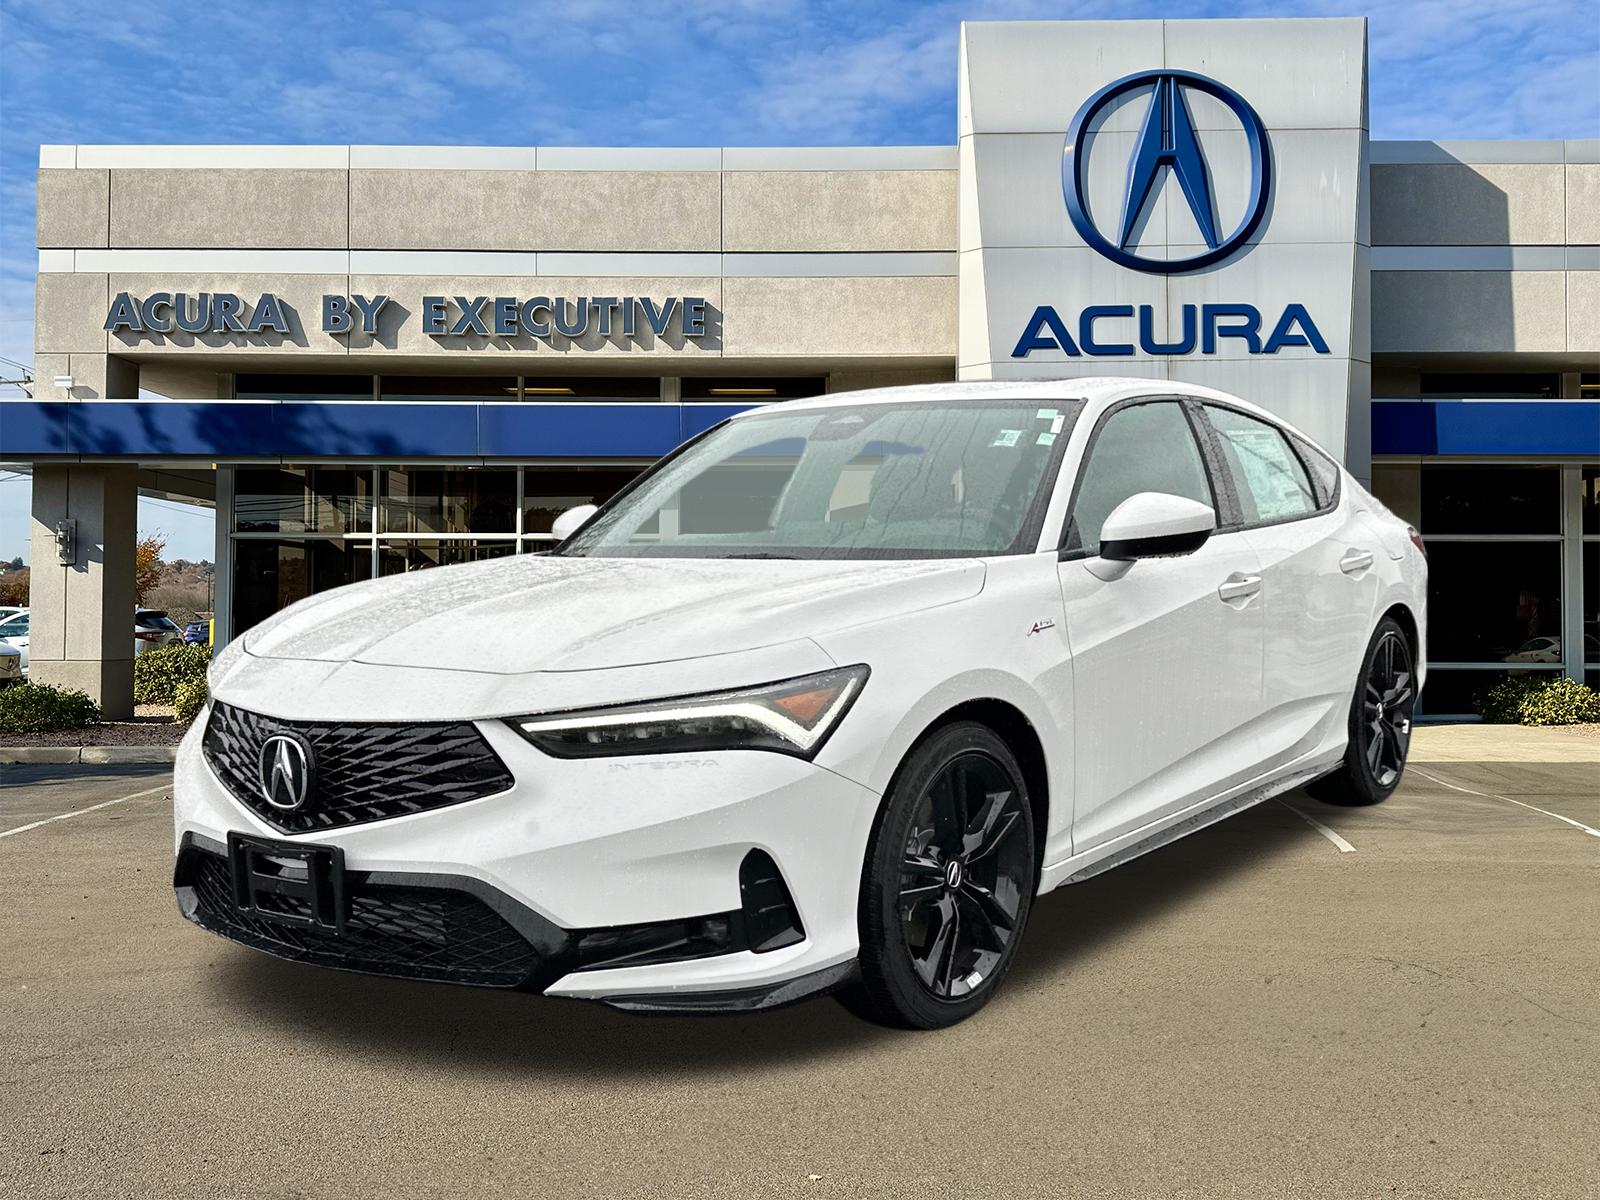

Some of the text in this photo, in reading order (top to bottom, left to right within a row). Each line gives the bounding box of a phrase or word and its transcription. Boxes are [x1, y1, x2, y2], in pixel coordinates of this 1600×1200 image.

[103, 292, 706, 337] ACURA BY EXECUTIVE
[1011, 303, 1332, 357] ACURA
